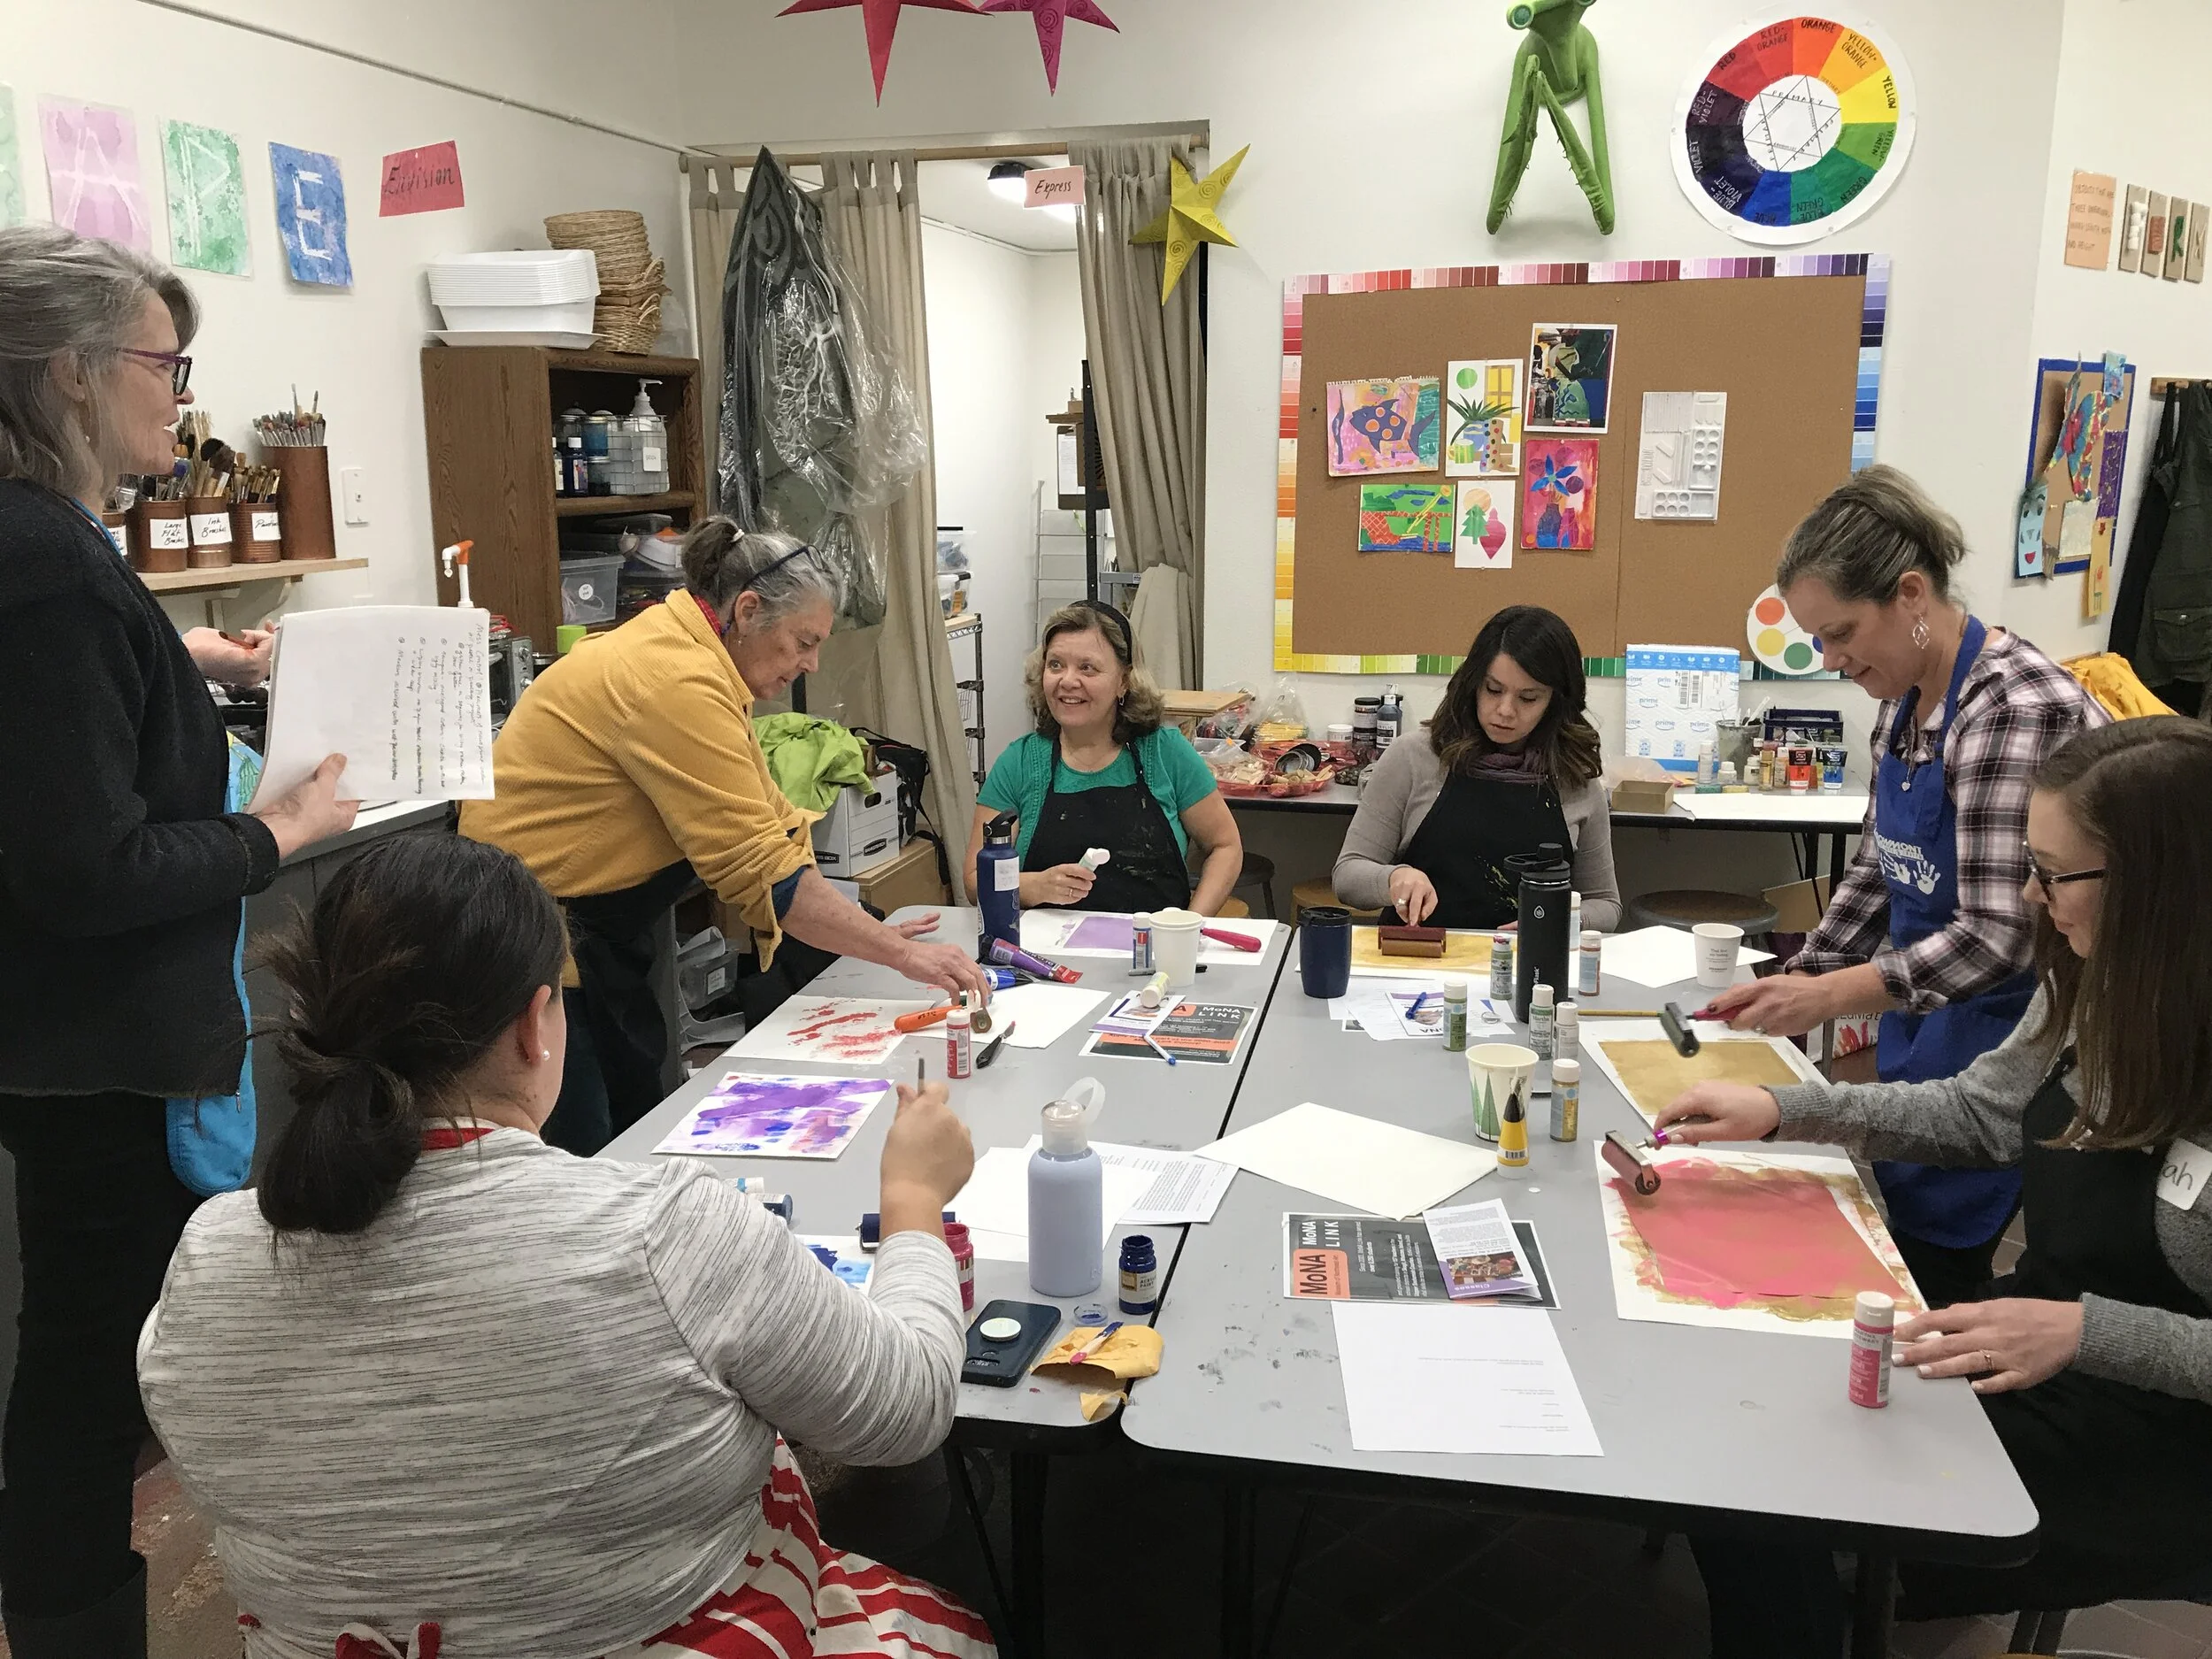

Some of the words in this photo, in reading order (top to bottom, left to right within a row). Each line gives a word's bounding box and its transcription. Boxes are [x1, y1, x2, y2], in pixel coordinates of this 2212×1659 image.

[1801, 19, 1836, 34] ORANGE
[1756, 35, 1788, 51] ORANGE
[1841, 42, 1867, 69] ORANGE
[1718, 52, 1737, 71] RED
[1699, 90, 1717, 124] VIOLET
[1689, 141, 1703, 174] VIOLET
[1871, 131, 1885, 157] GREEN
[384, 165, 455, 195] Envision
[1034, 180, 1071, 199] Express
[1714, 176, 1743, 203] VIOLET
[1840, 176, 1868, 204] GREEN
[290, 169, 332, 260] E
[1302, 1221, 1317, 1246] MoNA
[1325, 1221, 1340, 1248] LINK
[1300, 1254, 1328, 1295] MoNA
[1454, 1283, 1490, 1292] Classes
